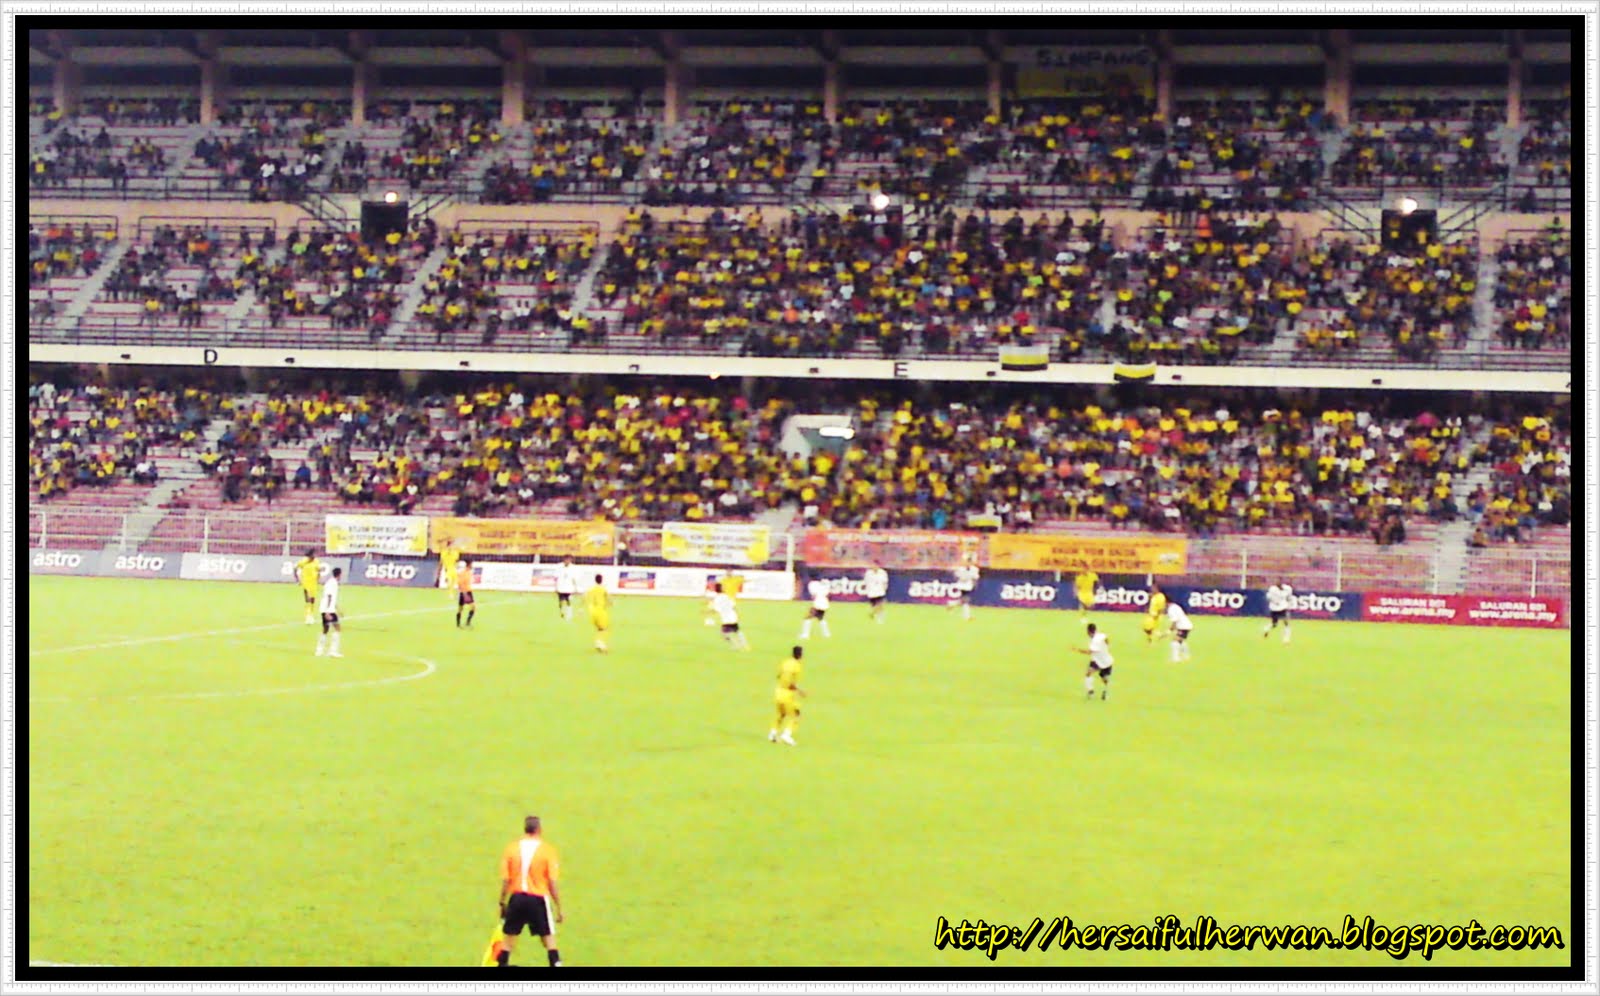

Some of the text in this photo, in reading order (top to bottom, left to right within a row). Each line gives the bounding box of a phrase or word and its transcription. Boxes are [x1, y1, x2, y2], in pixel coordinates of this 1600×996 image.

[204, 349, 218, 364] D
[894, 362, 909, 378] E
[33, 551, 81, 567] astro
[115, 553, 164, 571] astro
[197, 557, 247, 574] astro
[365, 562, 416, 580] astro
[908, 579, 961, 598] astro
[1001, 582, 1056, 602] astro
[1095, 586, 1149, 606] astro
[1188, 589, 1245, 609] astro
[1288, 593, 1342, 612] astro
